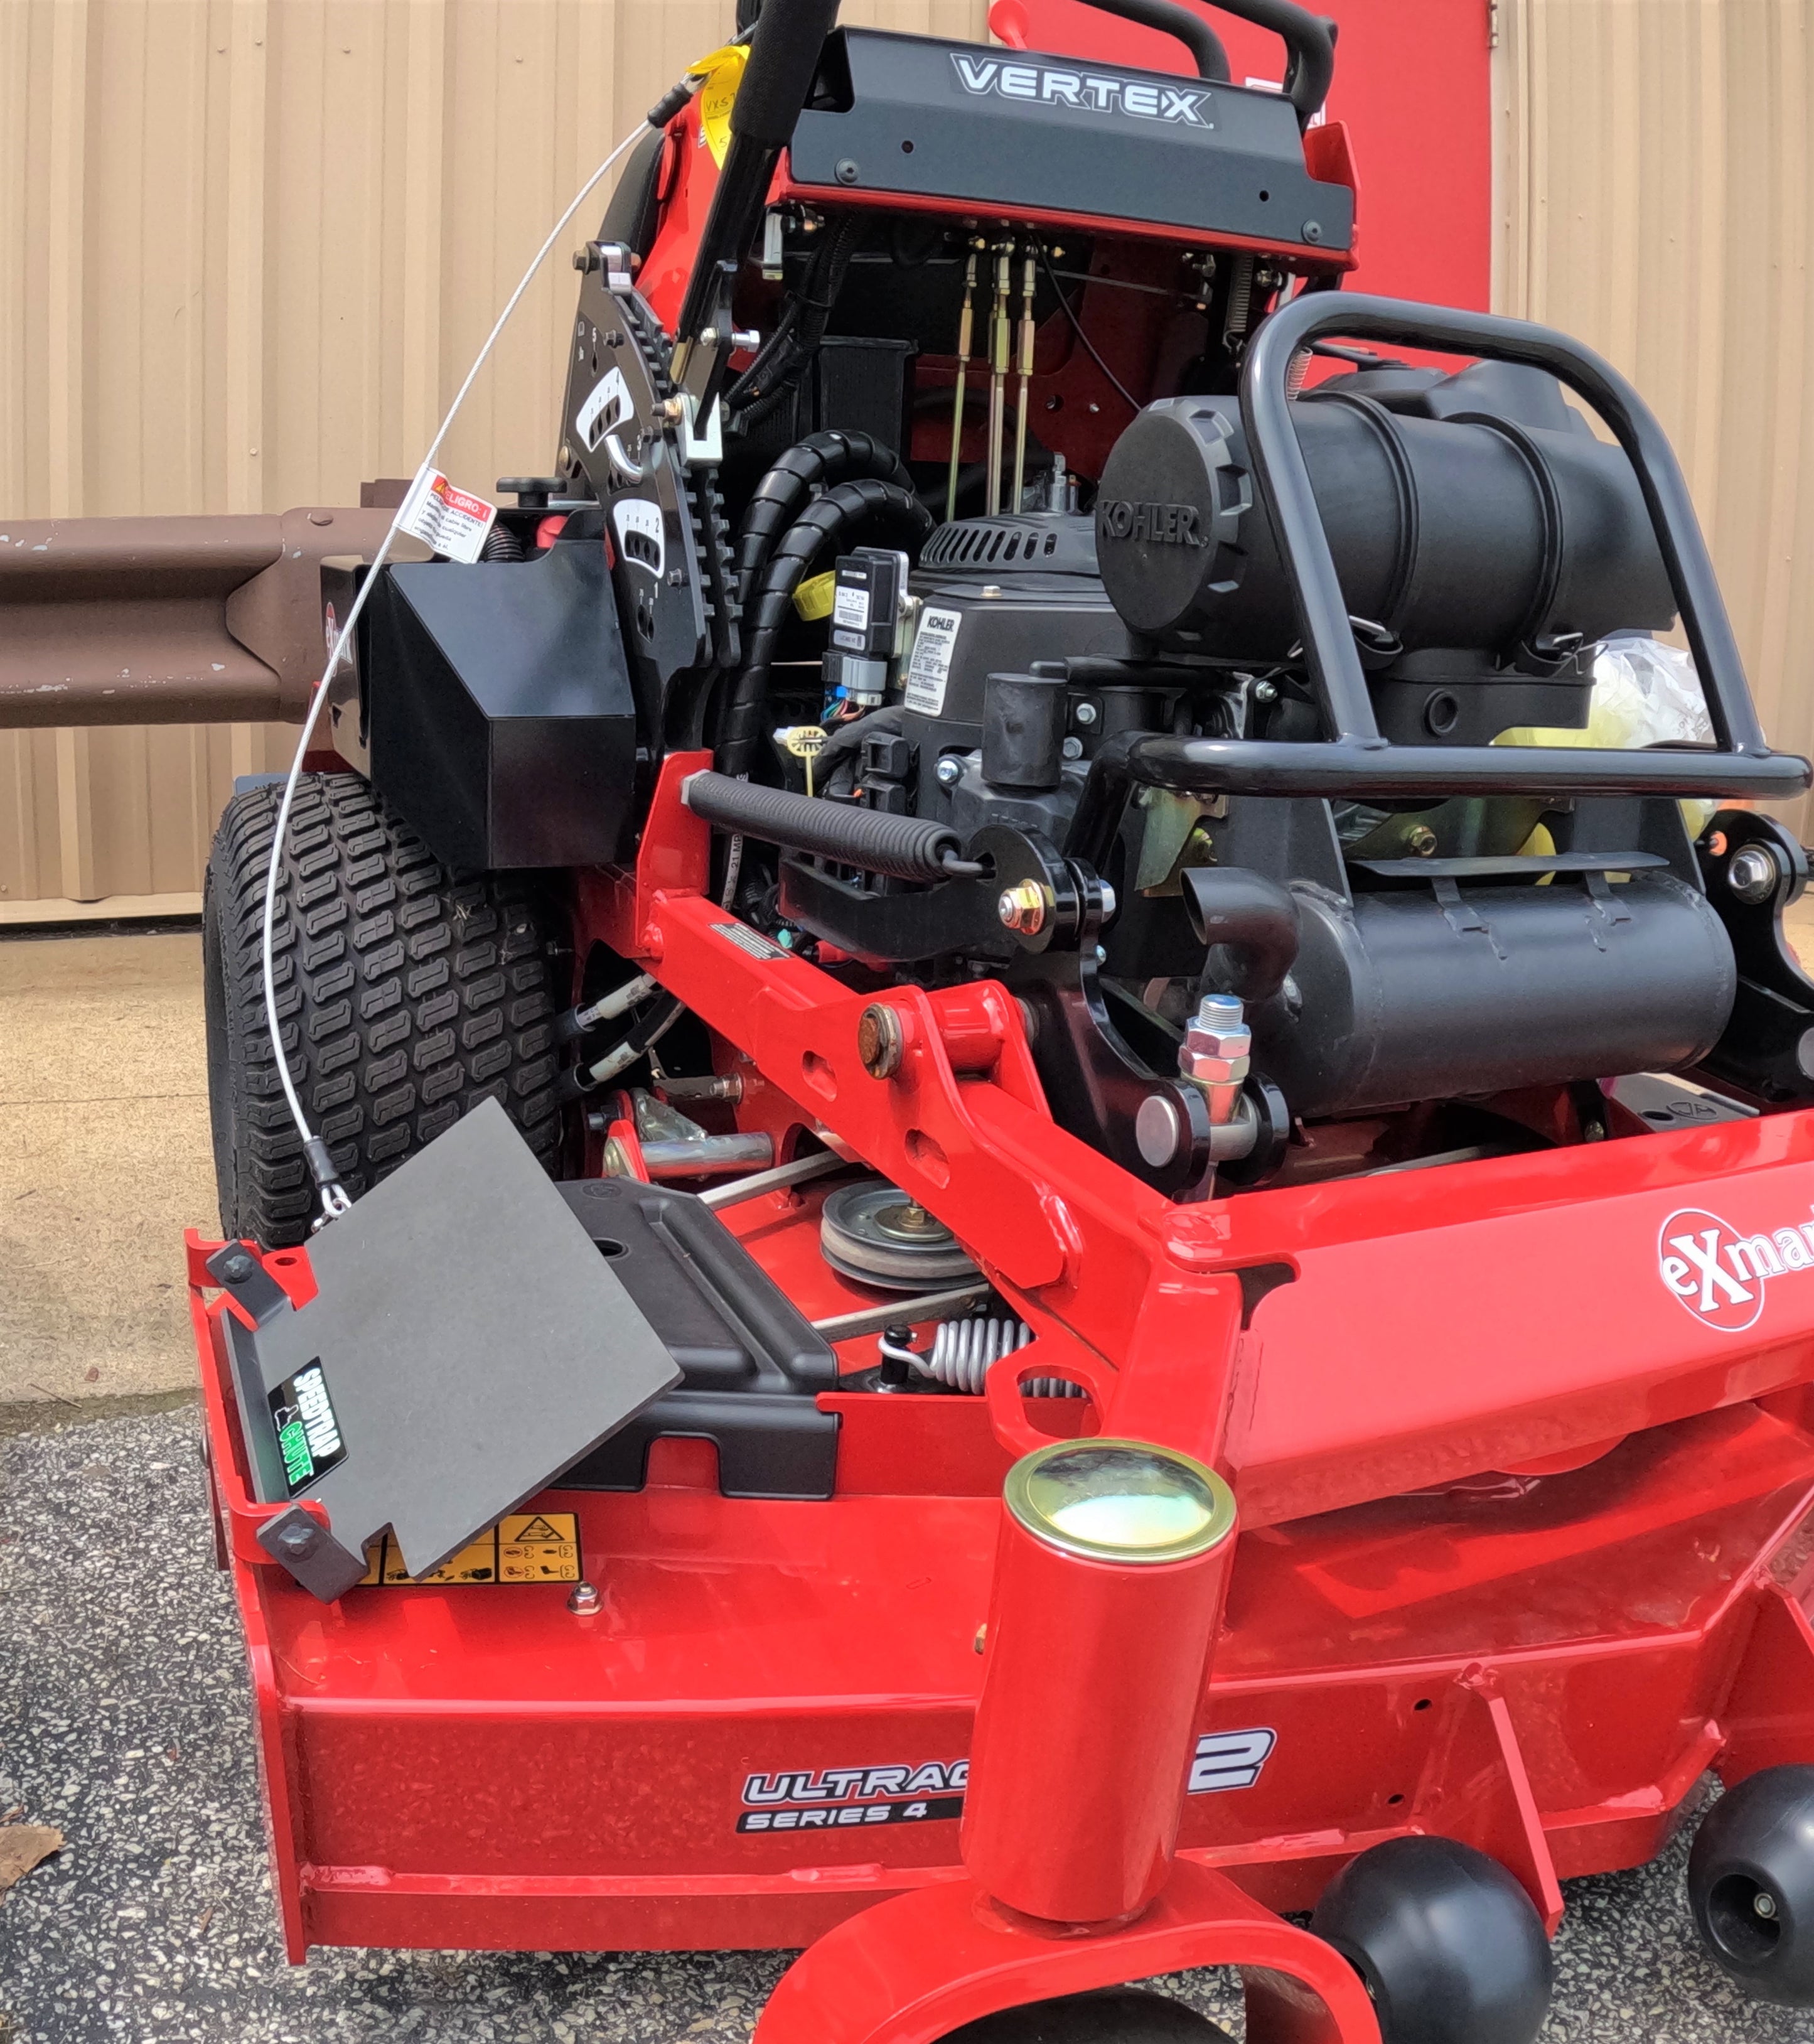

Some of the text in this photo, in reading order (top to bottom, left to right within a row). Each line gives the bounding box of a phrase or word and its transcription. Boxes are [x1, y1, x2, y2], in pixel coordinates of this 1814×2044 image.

[952, 54, 1213, 129] VERTEX
[444, 490, 482, 514] ELIGRO:
[1098, 500, 1200, 546] KOHLER
[927, 615, 955, 632] KOHLER
[293, 1367, 341, 1458] SPEEDTRAP
[279, 1420, 314, 1486] CHUTE
[744, 1802, 928, 1829] SERIES 4
